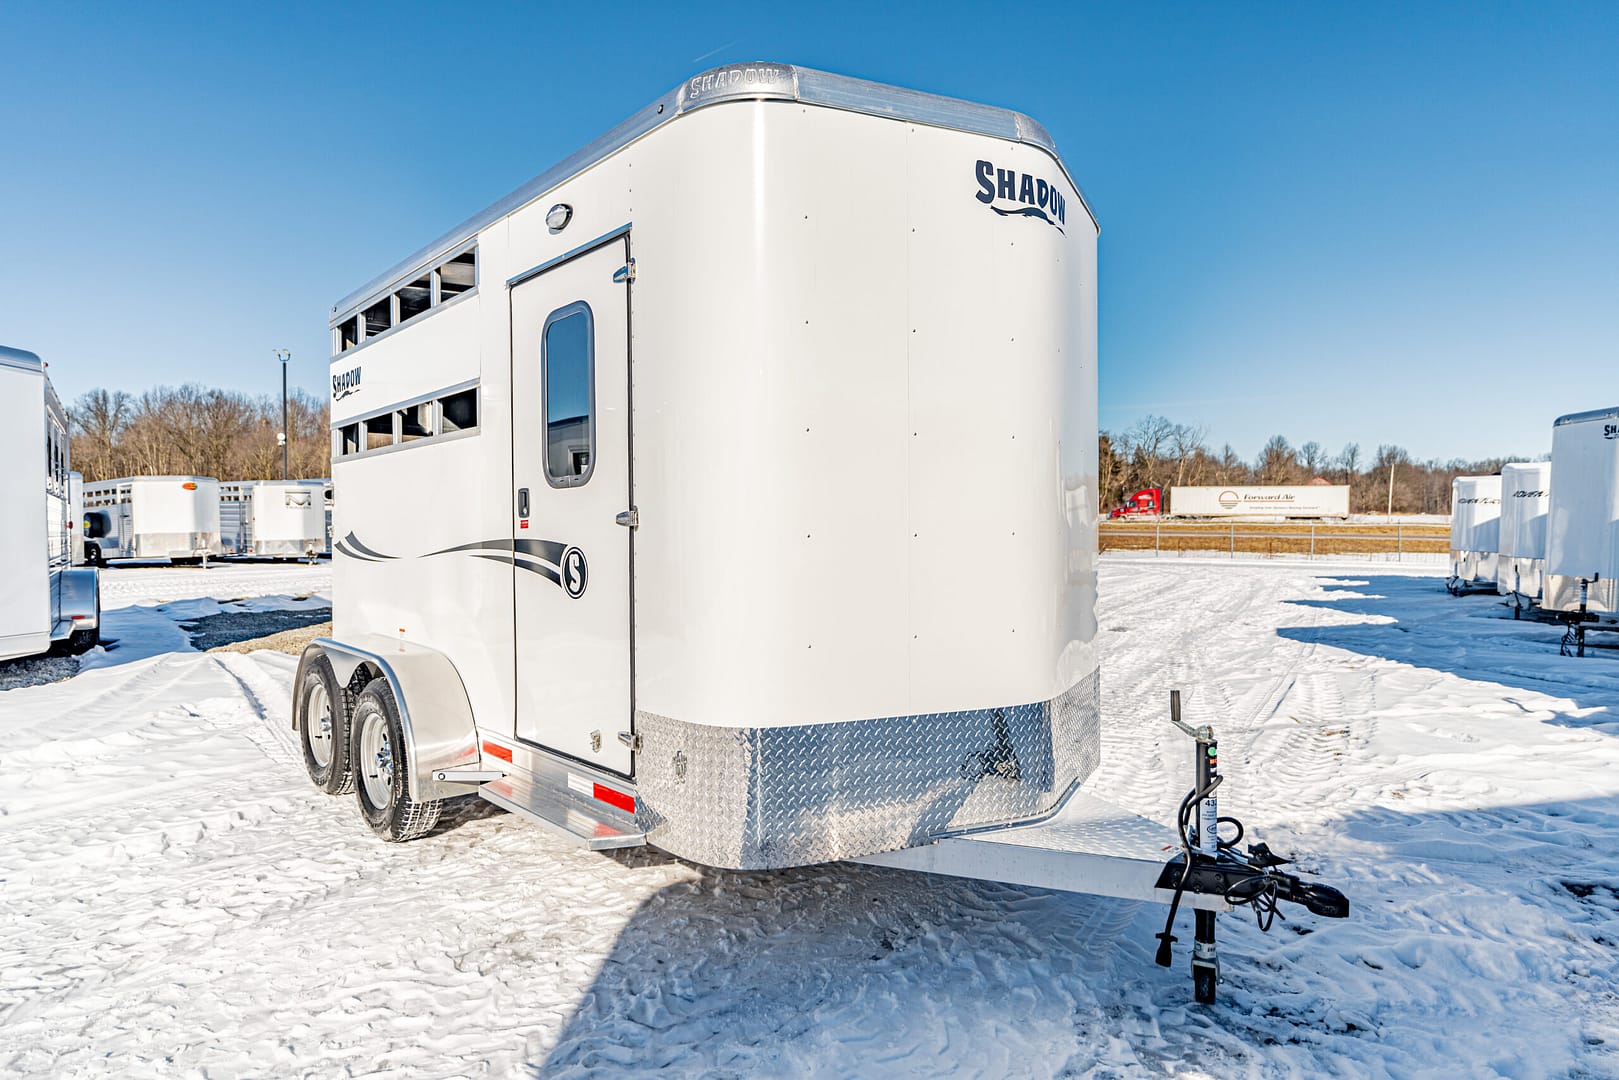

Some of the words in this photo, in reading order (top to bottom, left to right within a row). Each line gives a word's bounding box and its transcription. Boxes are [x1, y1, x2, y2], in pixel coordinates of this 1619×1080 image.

[690, 68, 779, 99] SHADOW
[975, 159, 1066, 226] SHADOW
[332, 366, 362, 398] SHADOW
[1243, 493, 1281, 501] Forward
[1281, 493, 1295, 501] Air
[568, 553, 581, 593] S
